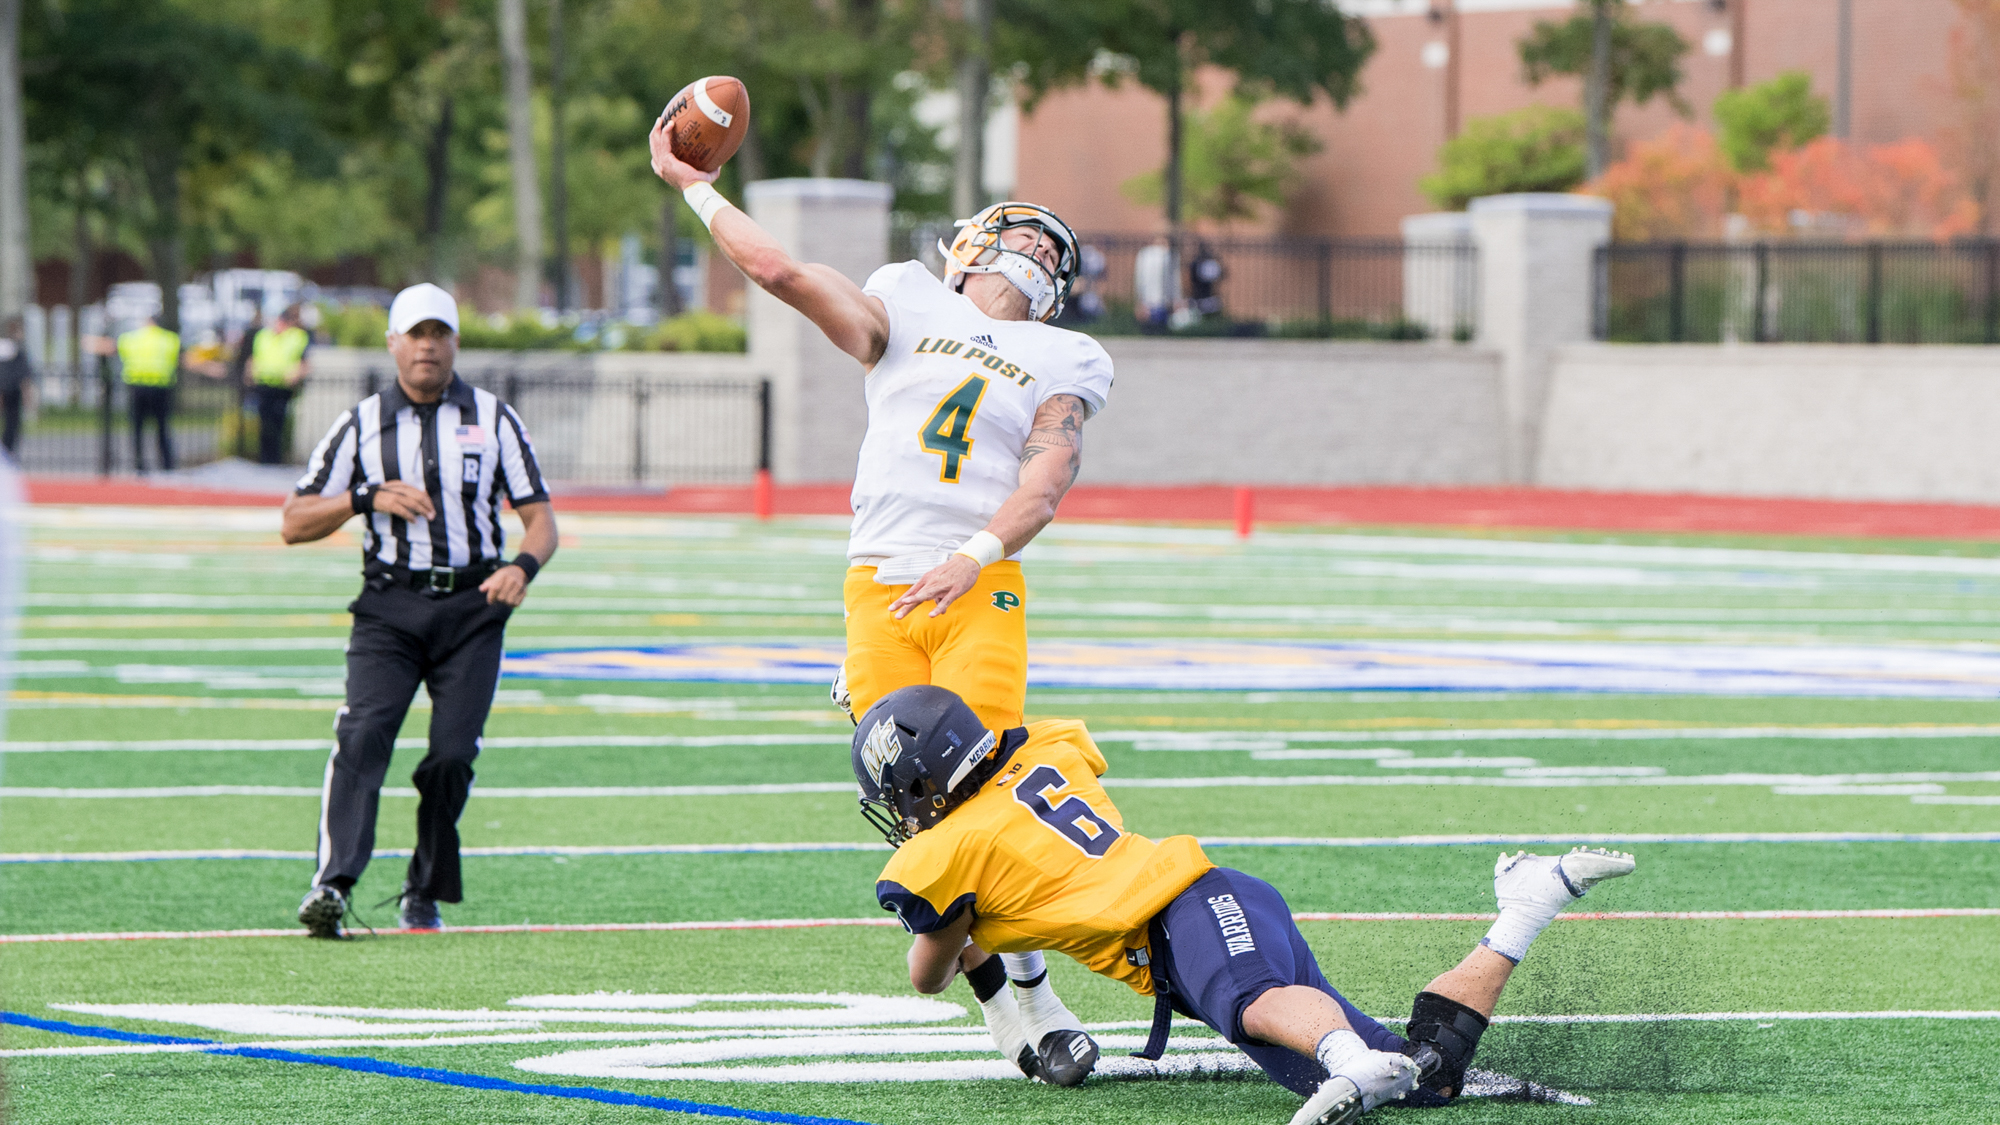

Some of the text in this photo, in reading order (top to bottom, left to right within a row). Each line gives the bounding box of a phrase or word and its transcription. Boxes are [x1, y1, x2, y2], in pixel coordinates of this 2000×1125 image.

[914, 337, 1036, 388] LIU POST
[970, 336, 998, 350] adidas
[917, 372, 991, 484] 4
[463, 457, 479, 483] R
[990, 590, 1020, 613] P
[1011, 764, 1123, 859] 6
[1207, 893, 1256, 957] WARRIORS
